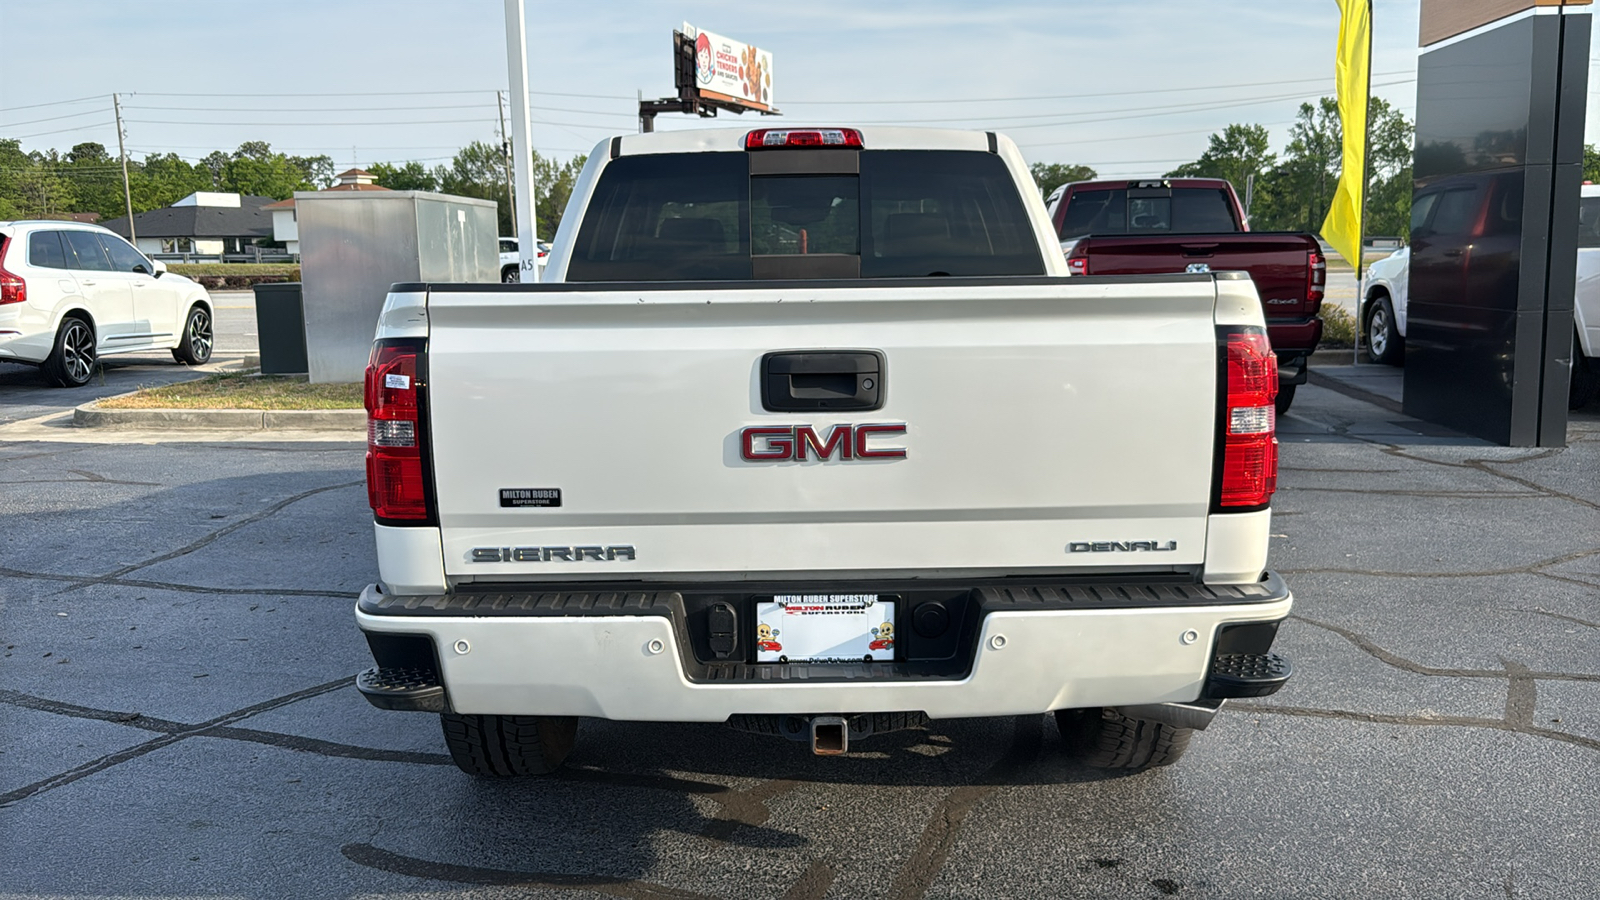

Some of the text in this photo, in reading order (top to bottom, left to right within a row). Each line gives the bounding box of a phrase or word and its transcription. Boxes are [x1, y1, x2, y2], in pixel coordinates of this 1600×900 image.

[716, 50, 738, 64] CHICKEN
[716, 60, 738, 74] TENDERS
[521, 259, 533, 271] A5
[740, 423, 908, 462] GMC
[502, 490, 559, 499] MILTON RUBEN
[1070, 541, 1177, 552] DENALI
[472, 546, 636, 562] SIERRA
[774, 594, 878, 603] MILTON RUBEN SUPERSTORE
